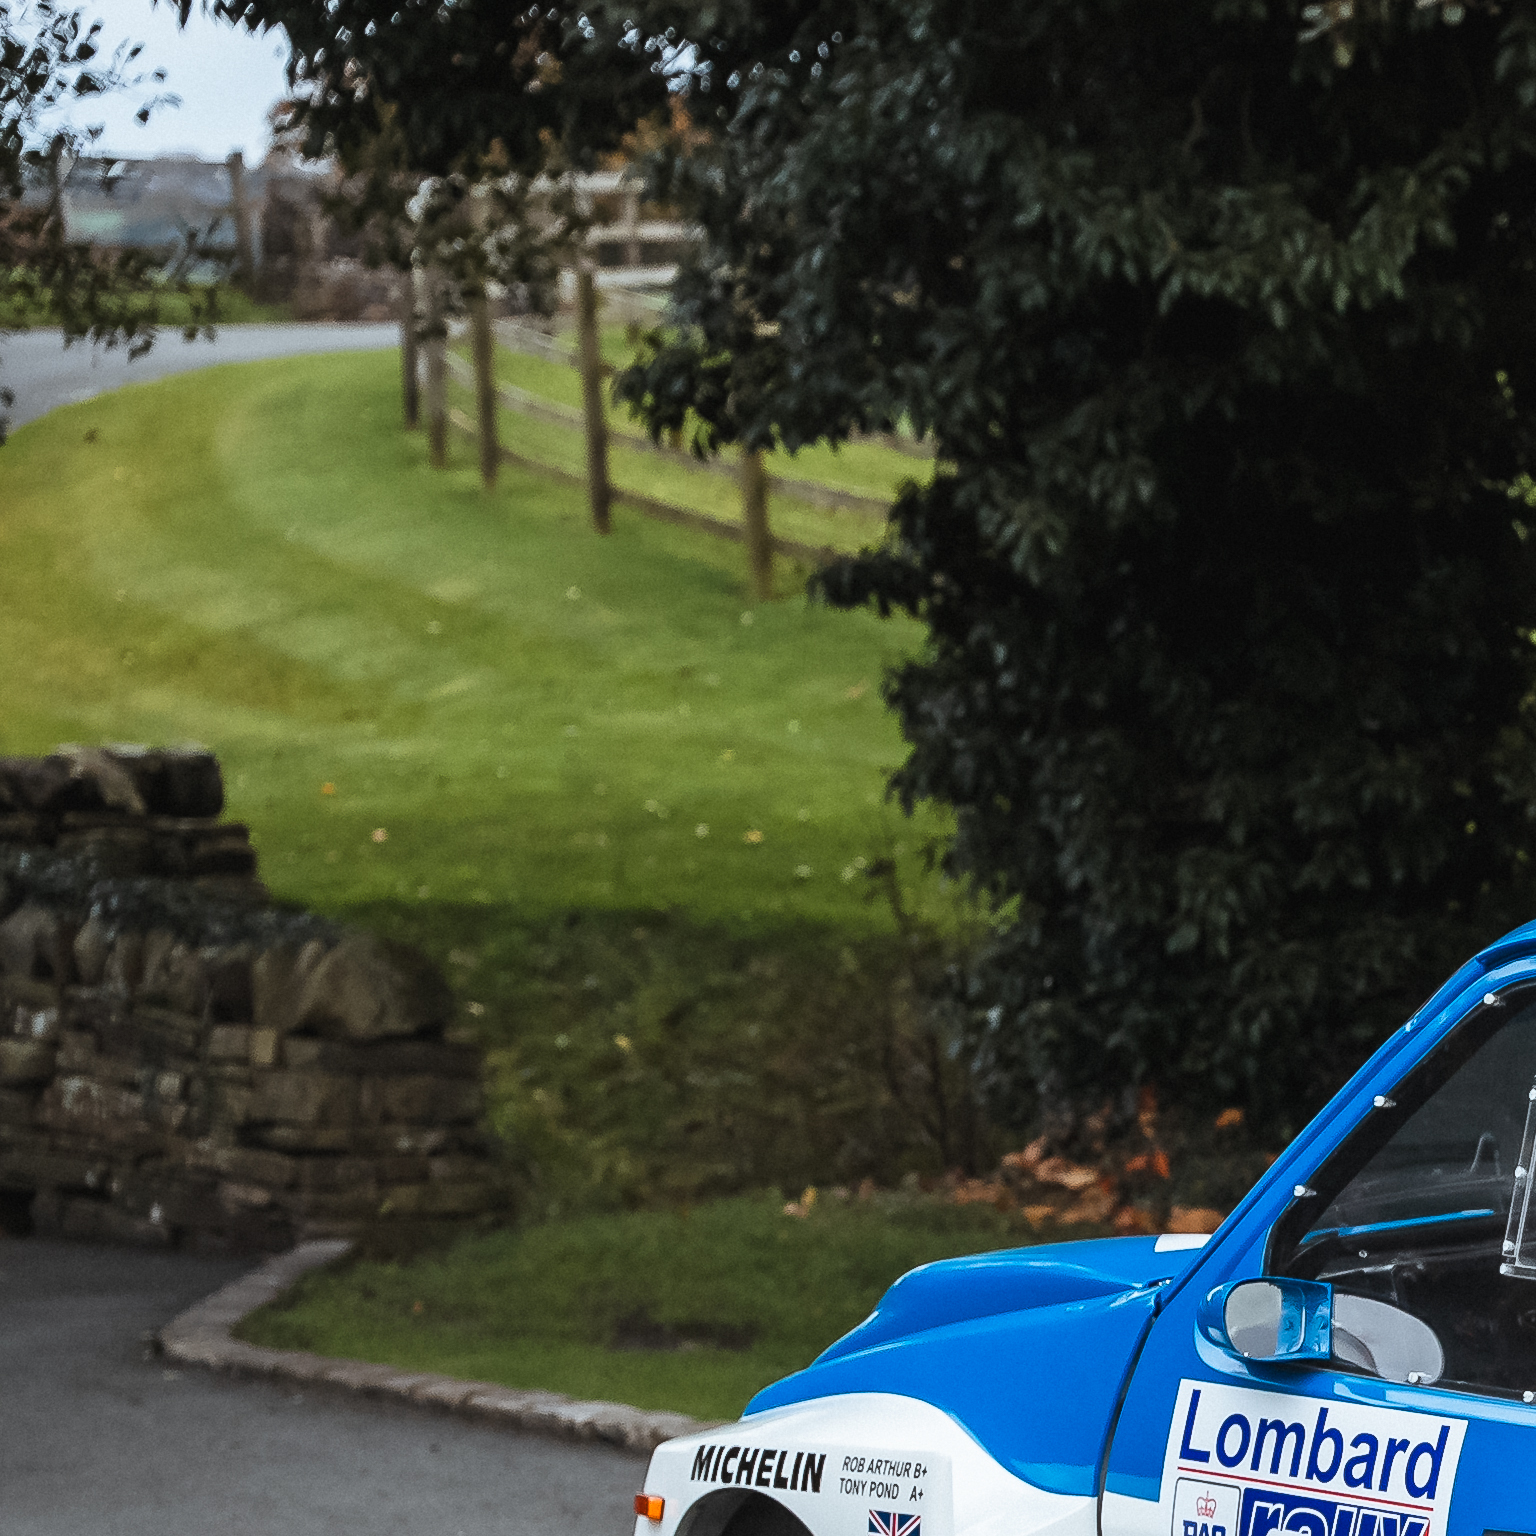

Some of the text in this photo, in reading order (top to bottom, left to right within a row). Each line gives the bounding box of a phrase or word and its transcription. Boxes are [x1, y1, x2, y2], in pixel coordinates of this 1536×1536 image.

[1179, 1389, 1451, 1501] Lombard
[690, 1444, 827, 1493] MICHELIN
[842, 1455, 928, 1479] ROB ARTHUR B+
[838, 1477, 924, 1501] TONY POND A+
